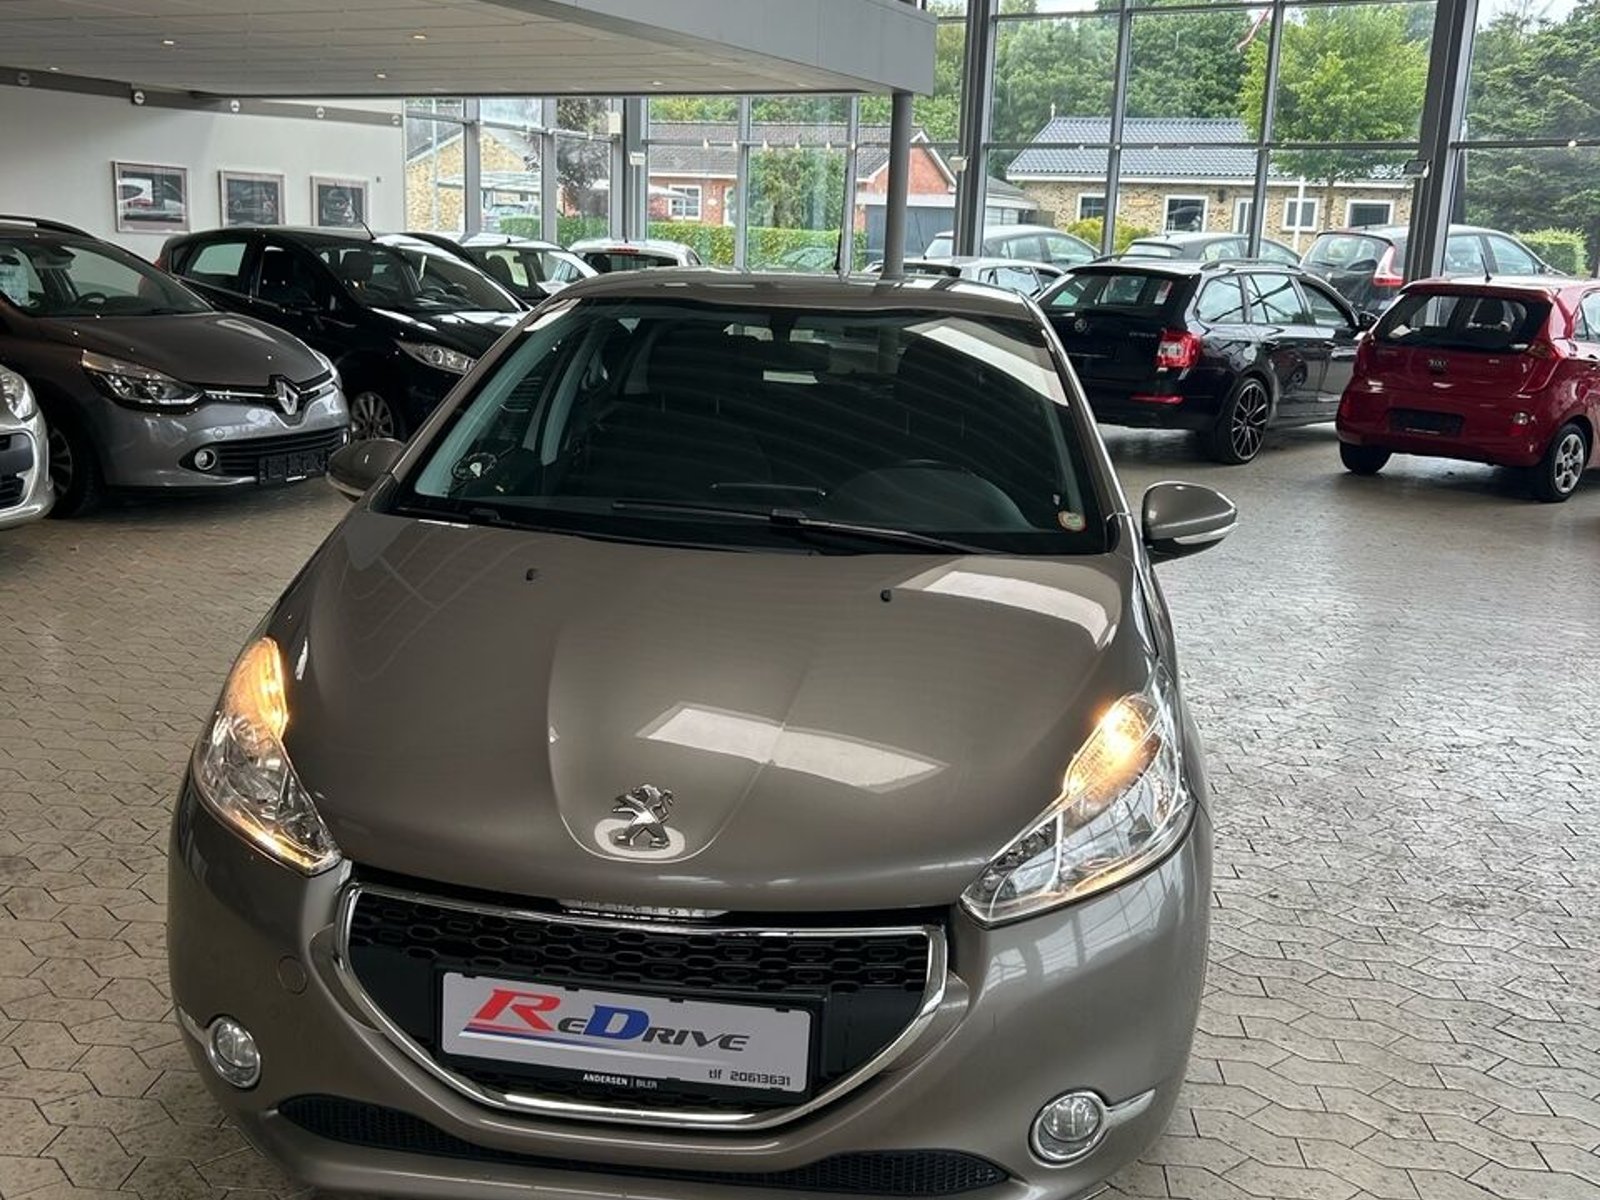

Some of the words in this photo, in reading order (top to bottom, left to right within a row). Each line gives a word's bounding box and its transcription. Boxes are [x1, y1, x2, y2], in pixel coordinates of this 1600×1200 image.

[582, 1073, 628, 1086] ANDERSEN
[635, 1079, 658, 1089] BILER
[708, 1069, 722, 1080] tlf
[729, 1070, 791, 1086] 20613631
